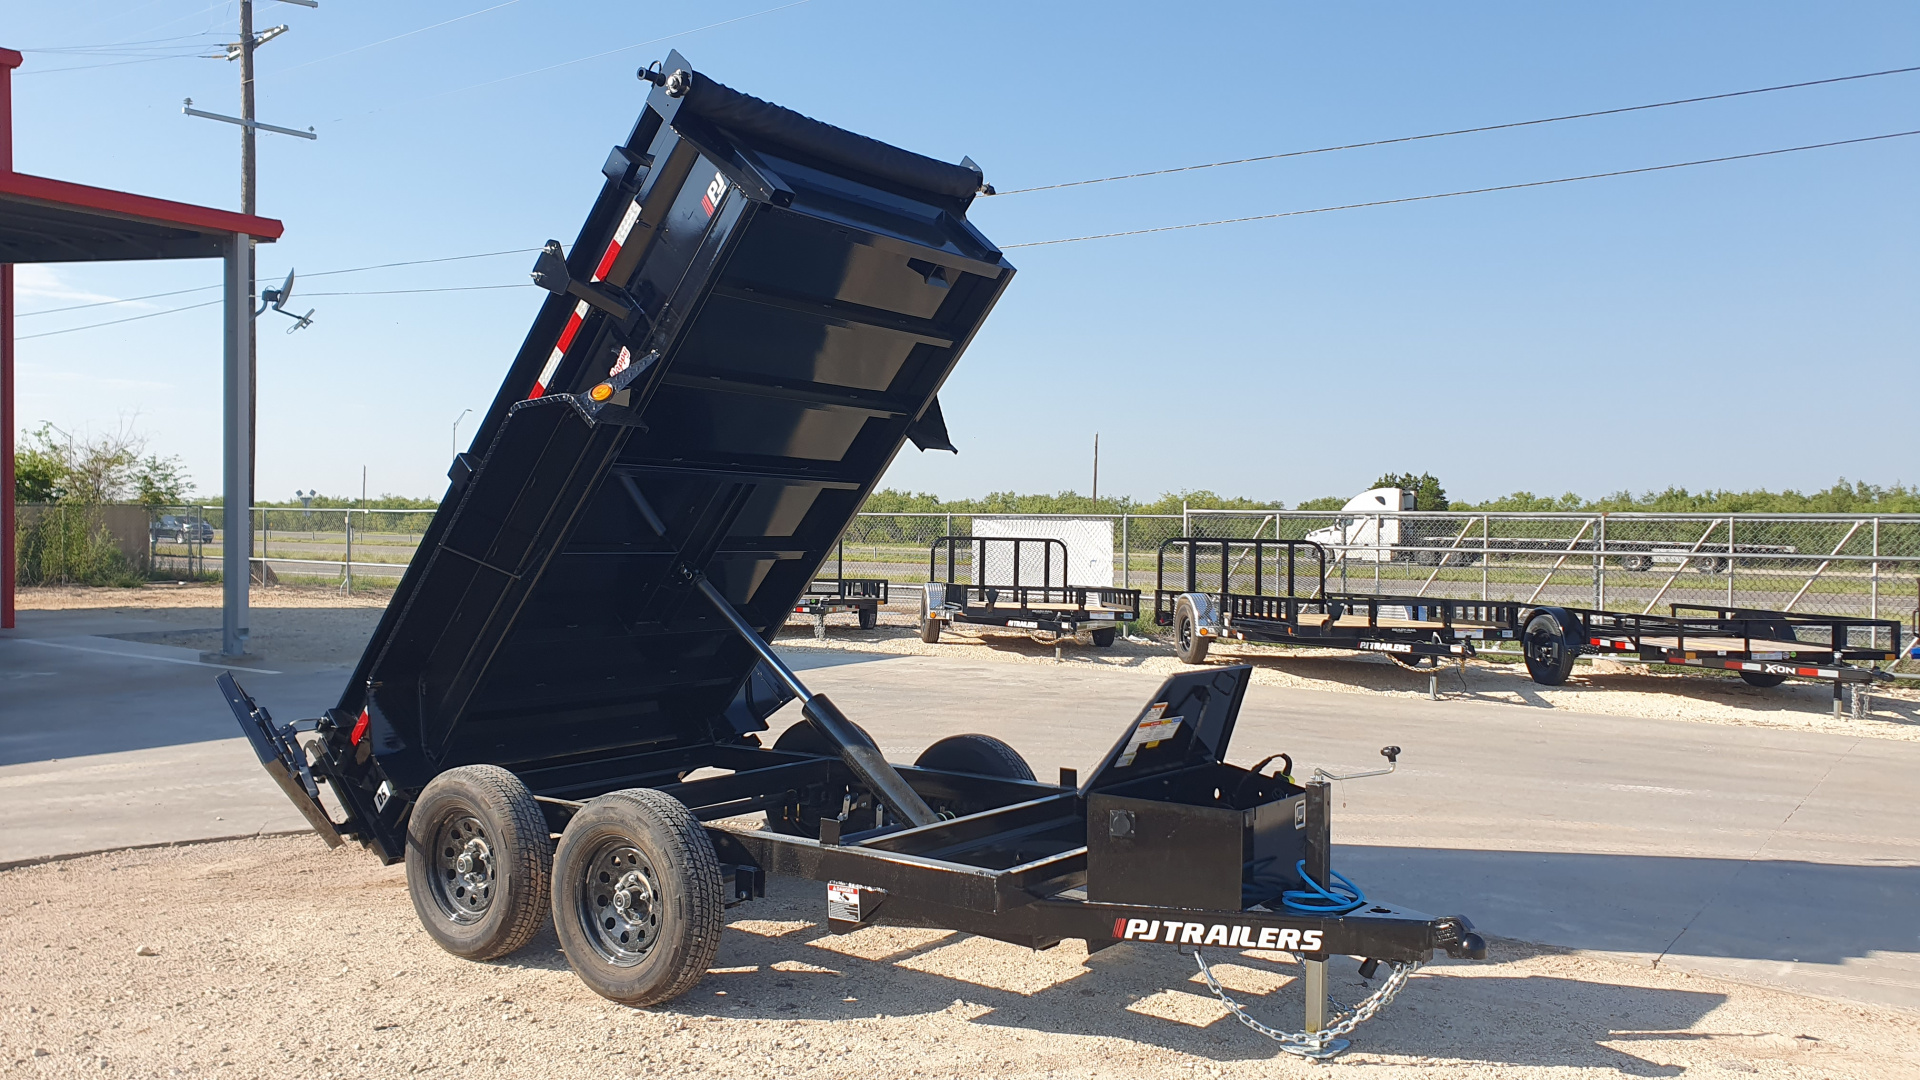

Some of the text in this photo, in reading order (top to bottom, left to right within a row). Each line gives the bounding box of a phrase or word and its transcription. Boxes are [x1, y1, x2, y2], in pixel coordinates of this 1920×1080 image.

[706, 171, 727, 208] PJ
[1369, 642, 1412, 653] TRAILERS
[1124, 918, 1324, 951] PJ TRAILERS
